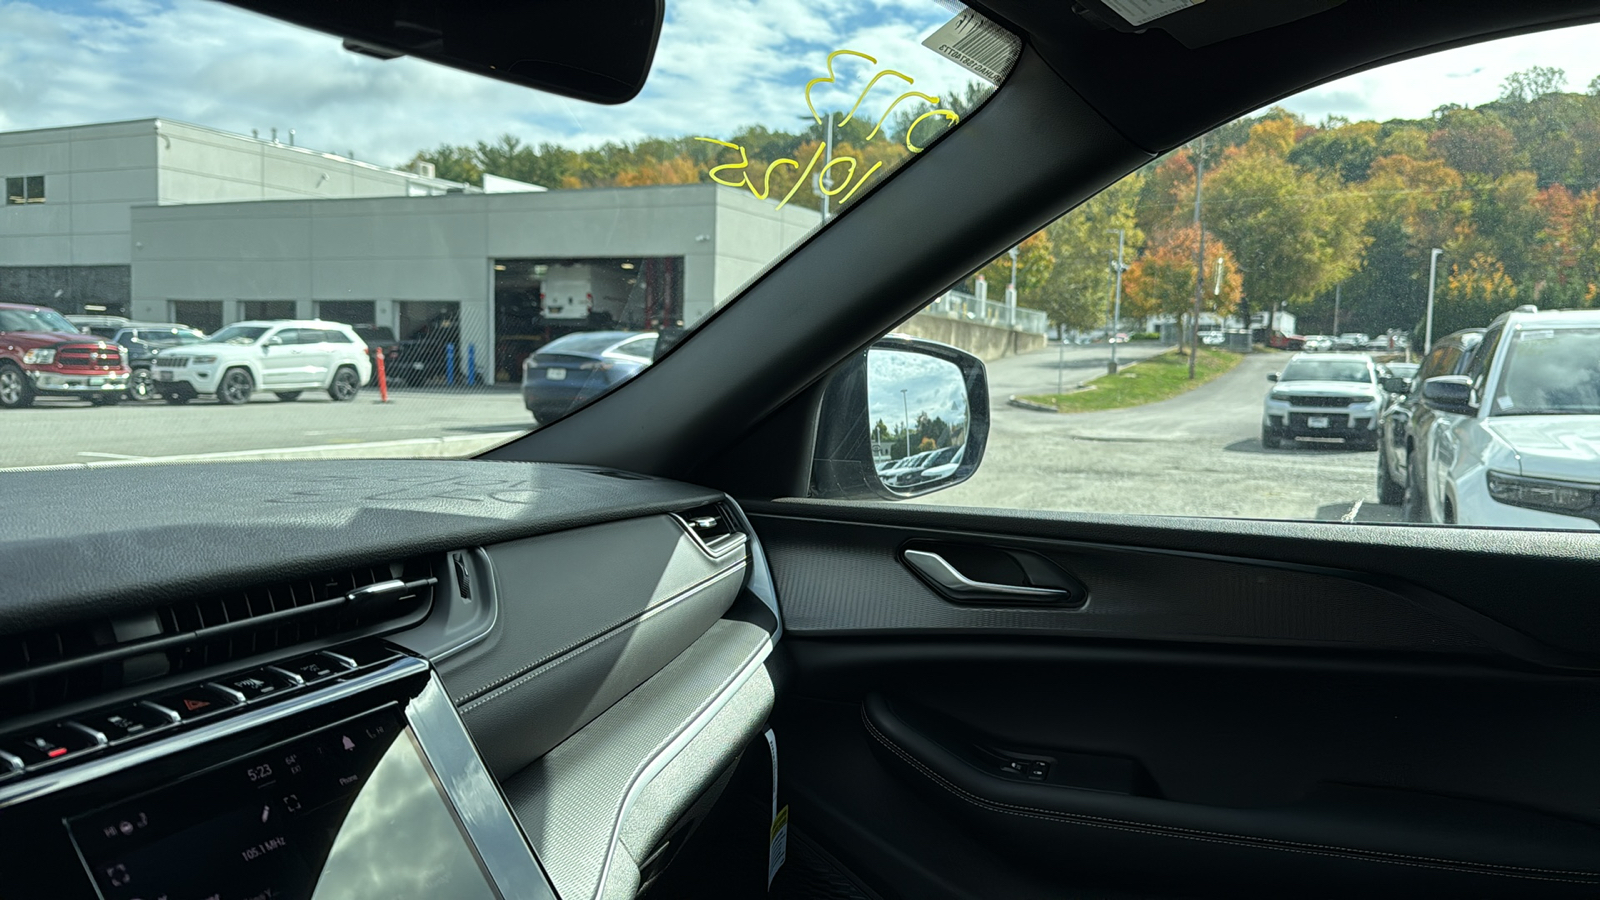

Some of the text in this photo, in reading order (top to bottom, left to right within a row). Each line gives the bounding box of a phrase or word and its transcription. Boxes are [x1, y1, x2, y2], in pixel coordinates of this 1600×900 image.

[247, 764, 273, 781] 5:23
[339, 774, 358, 786] Phone
[242, 836, 286, 861] 105.1 MHz
